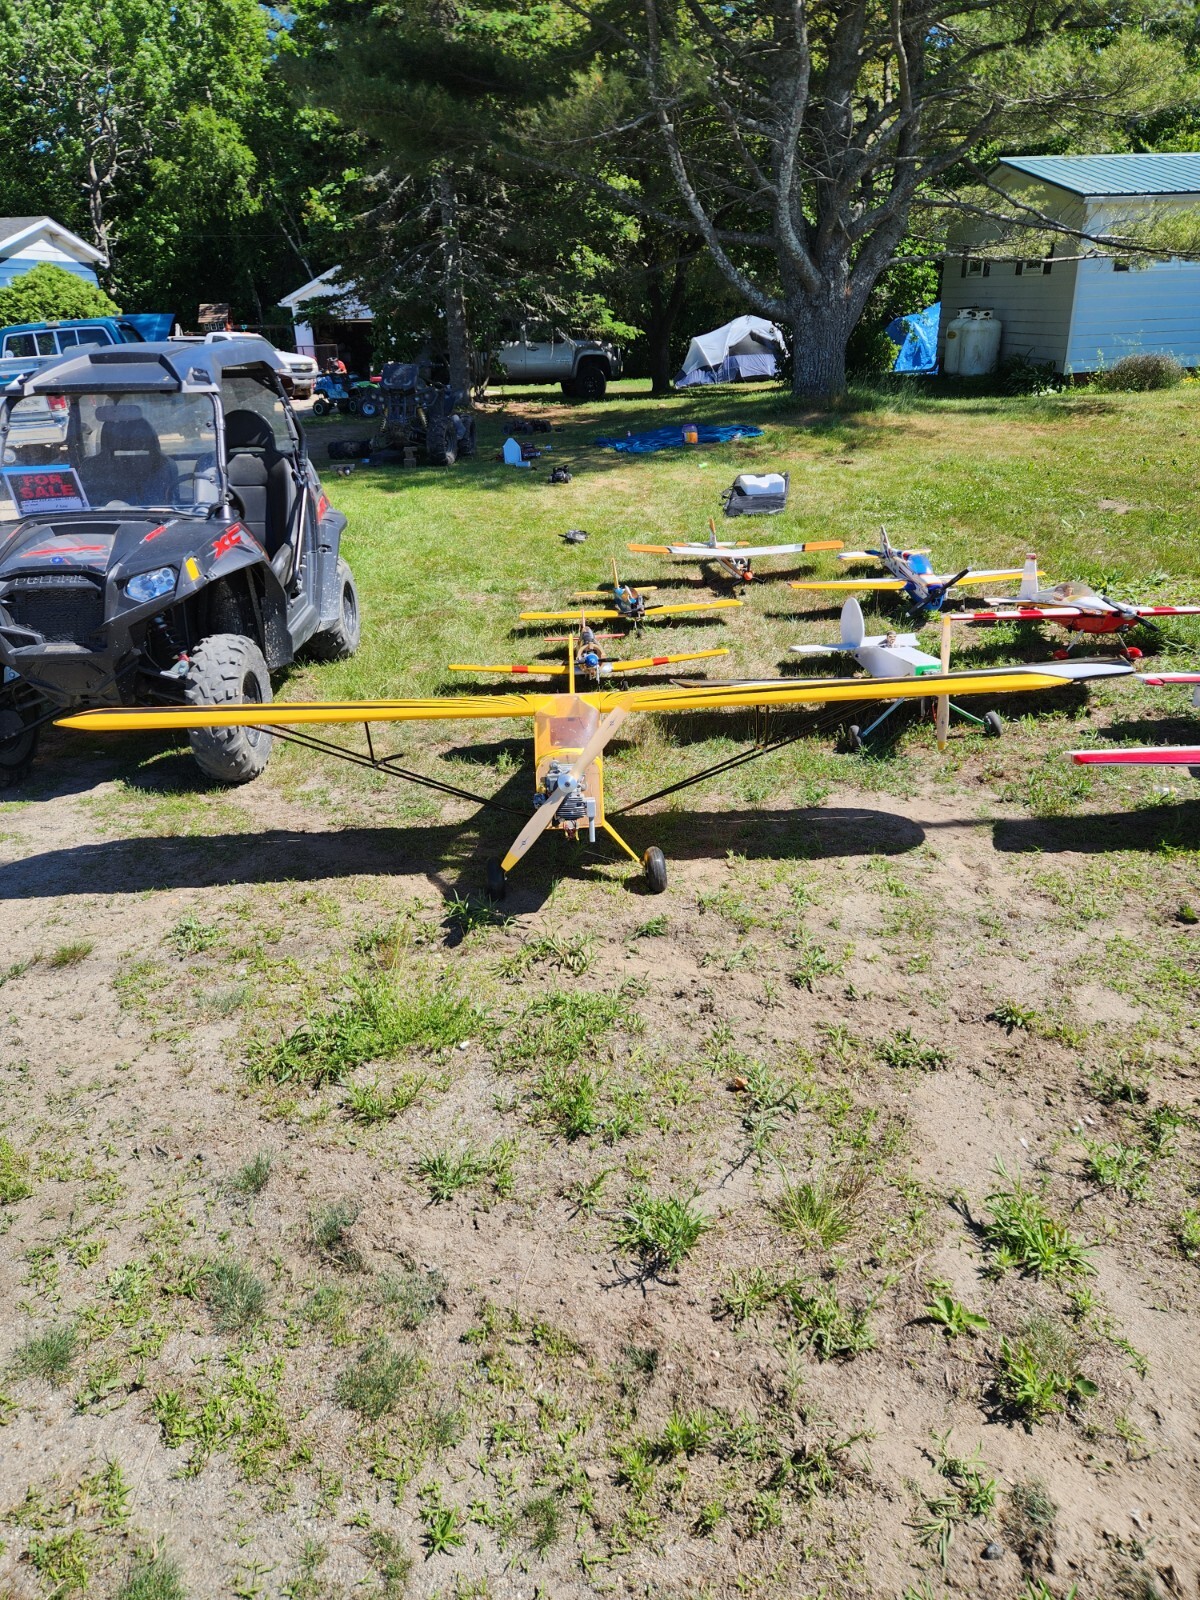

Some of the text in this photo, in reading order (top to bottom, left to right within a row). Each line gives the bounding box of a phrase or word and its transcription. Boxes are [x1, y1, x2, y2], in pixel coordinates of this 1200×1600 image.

[22, 474, 63, 486] FOR
[20, 484, 75, 499] SALE
[211, 525, 242, 559] XC
[14, 574, 89, 586] POLARIS
